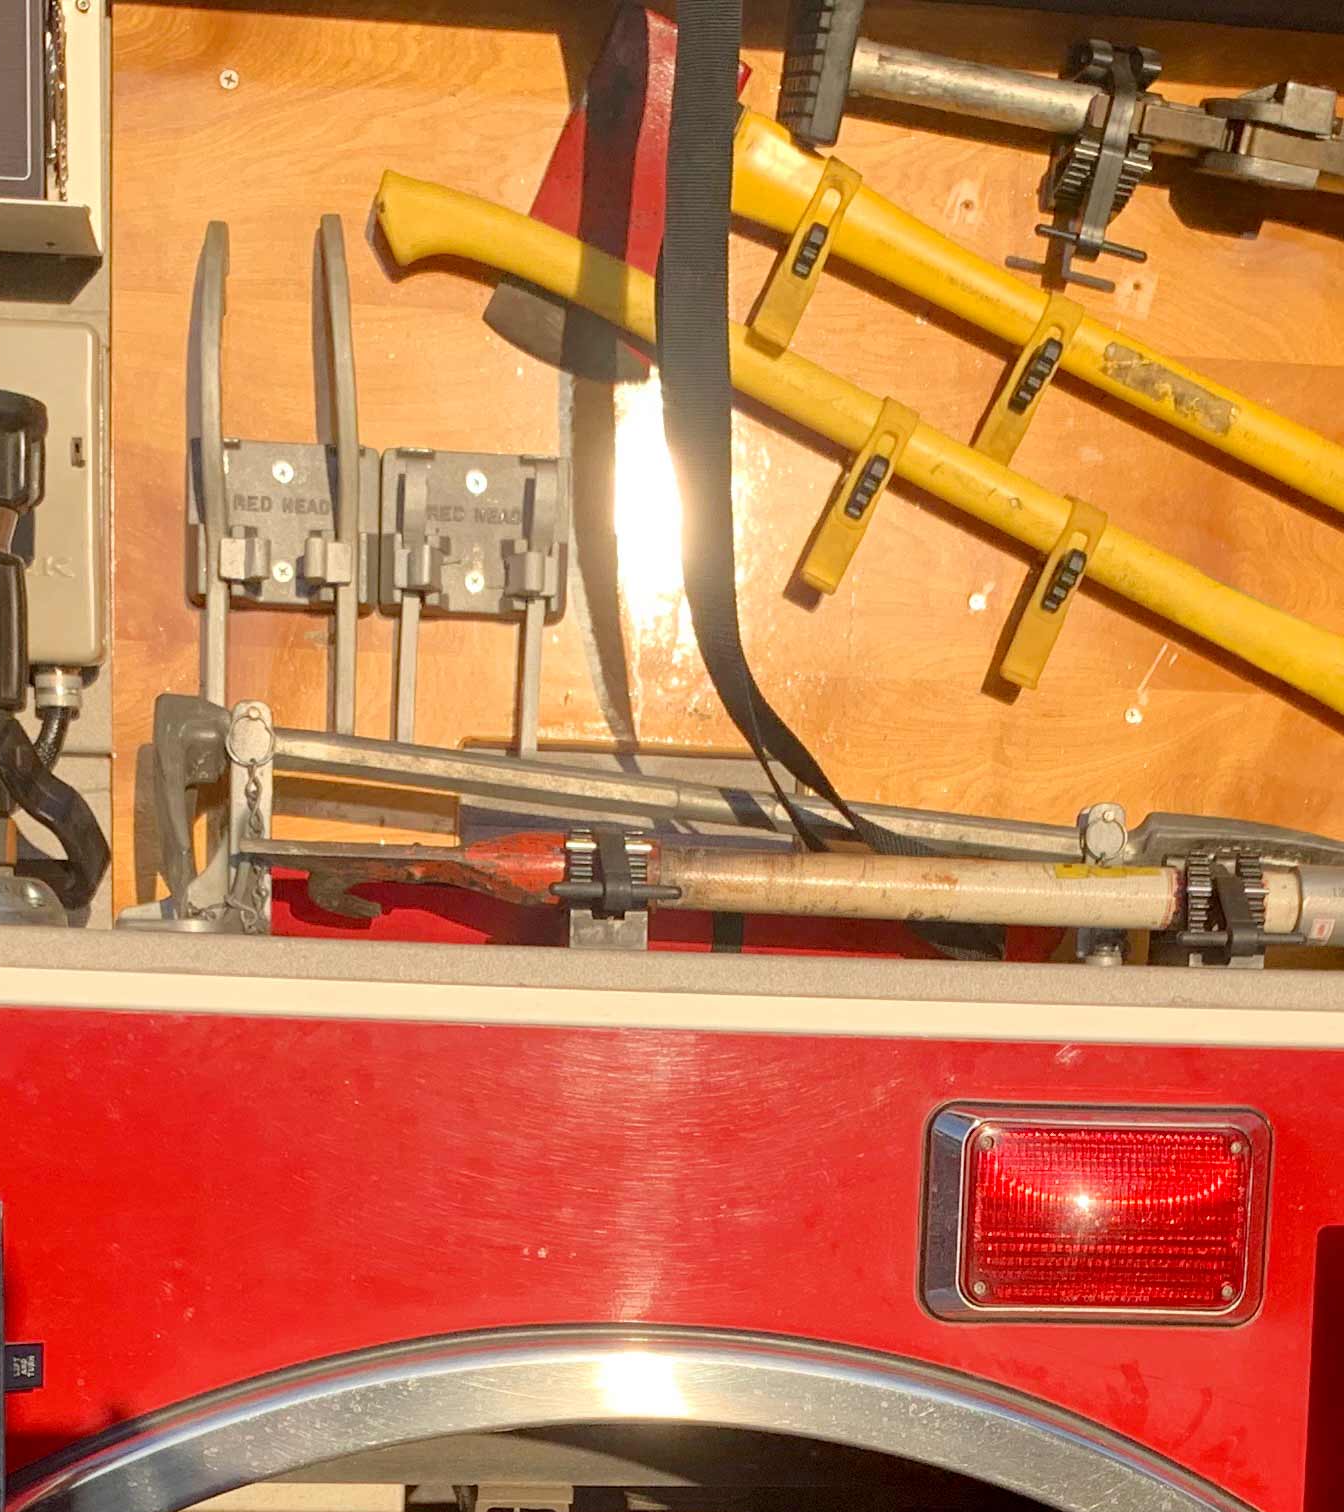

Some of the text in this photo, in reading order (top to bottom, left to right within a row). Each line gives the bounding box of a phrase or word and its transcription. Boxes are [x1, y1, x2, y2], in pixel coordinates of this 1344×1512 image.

[233, 494, 332, 516] RED HEAD
[427, 504, 466, 522] RED
